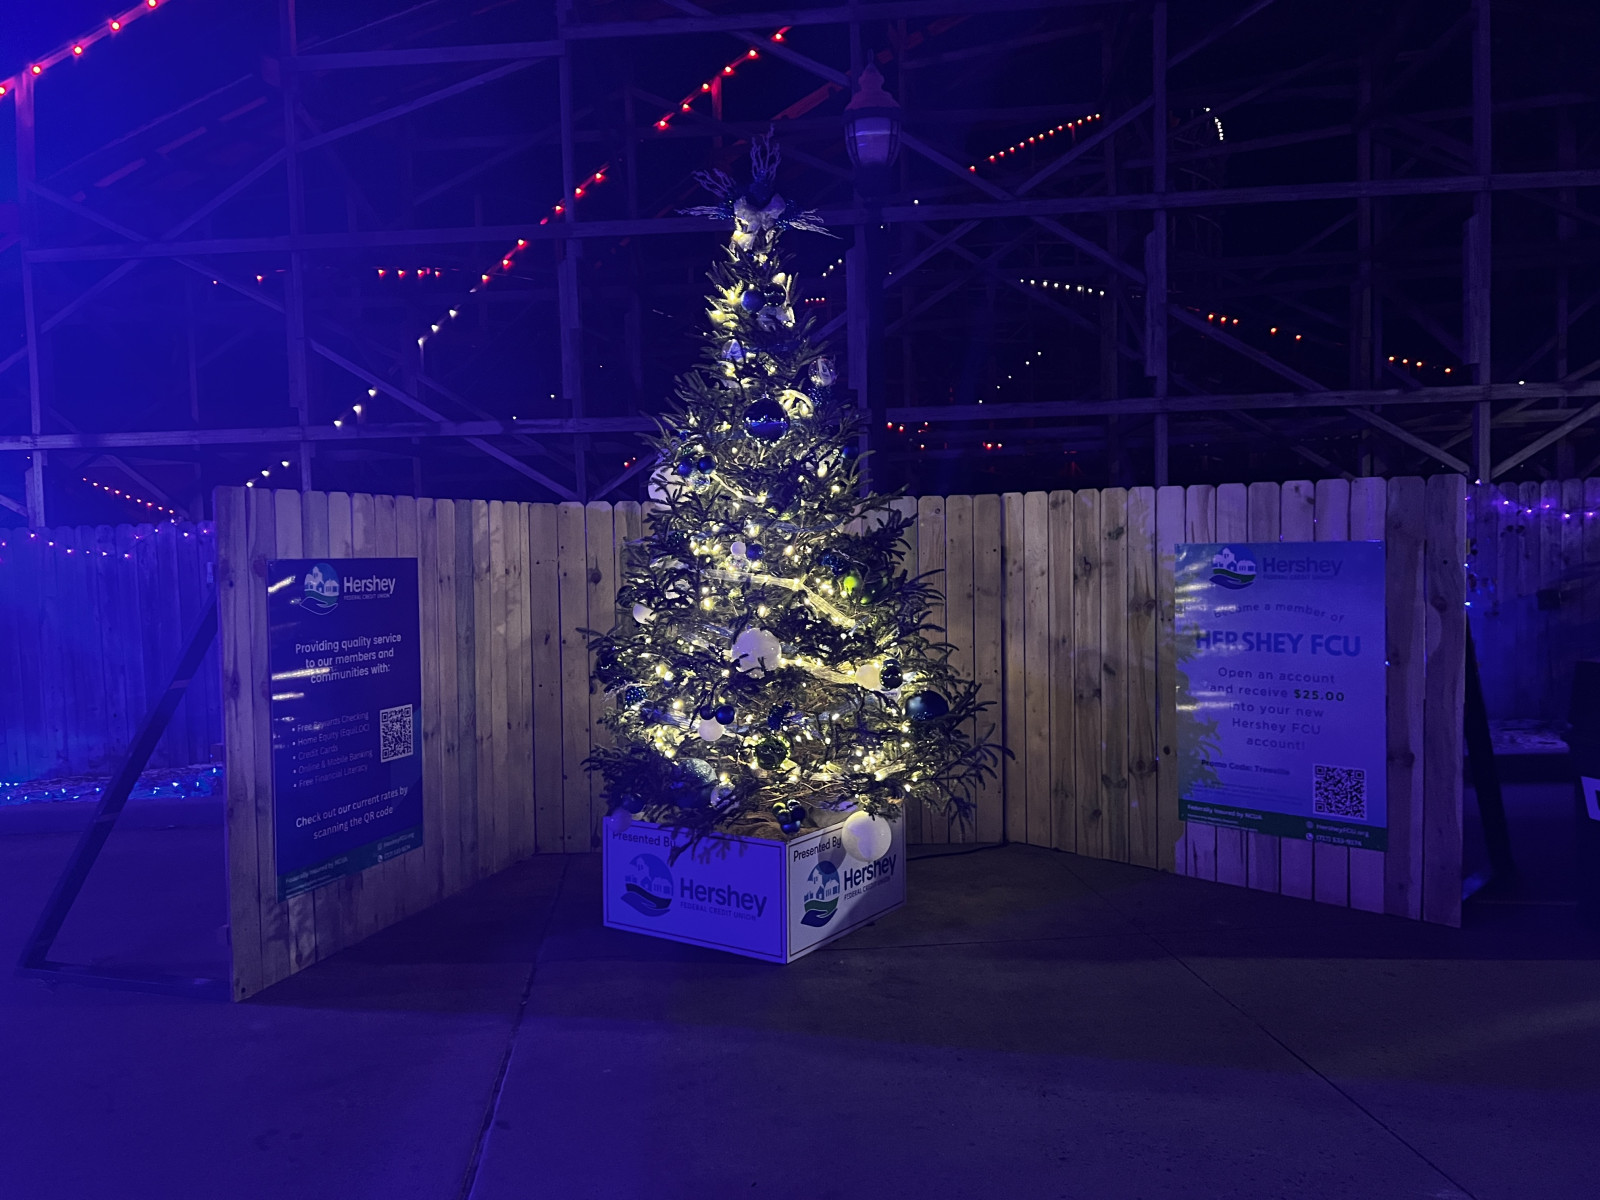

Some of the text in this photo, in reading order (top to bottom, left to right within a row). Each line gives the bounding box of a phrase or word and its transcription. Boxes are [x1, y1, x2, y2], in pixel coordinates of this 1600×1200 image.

[1262, 557, 1343, 575] Hershey
[344, 574, 396, 594] Hershey
[1276, 603, 1326, 618] member
[1330, 613, 1345, 624] of
[296, 633, 402, 654] Providing quality service
[1196, 630, 1361, 656] HERSHEY FCU
[306, 648, 394, 668] to our members and
[310, 663, 390, 684] communities with:
[1218, 666, 1335, 684] Open an account
[1210, 683, 1345, 702] and receive $25.00
[1229, 702, 1324, 718] into your new
[1232, 718, 1321, 735] Hershey FCU
[1246, 737, 1306, 750] account!
[296, 786, 408, 828] Check out our current rates by
[313, 805, 394, 840] scanning the QR code
[612, 832, 660, 846] Presented
[793, 836, 842, 862] Presented By
[844, 854, 897, 890] Hershey
[680, 877, 768, 918] Hershey
[680, 901, 708, 914] FEDERAL
[708, 906, 732, 918] CREDIT
